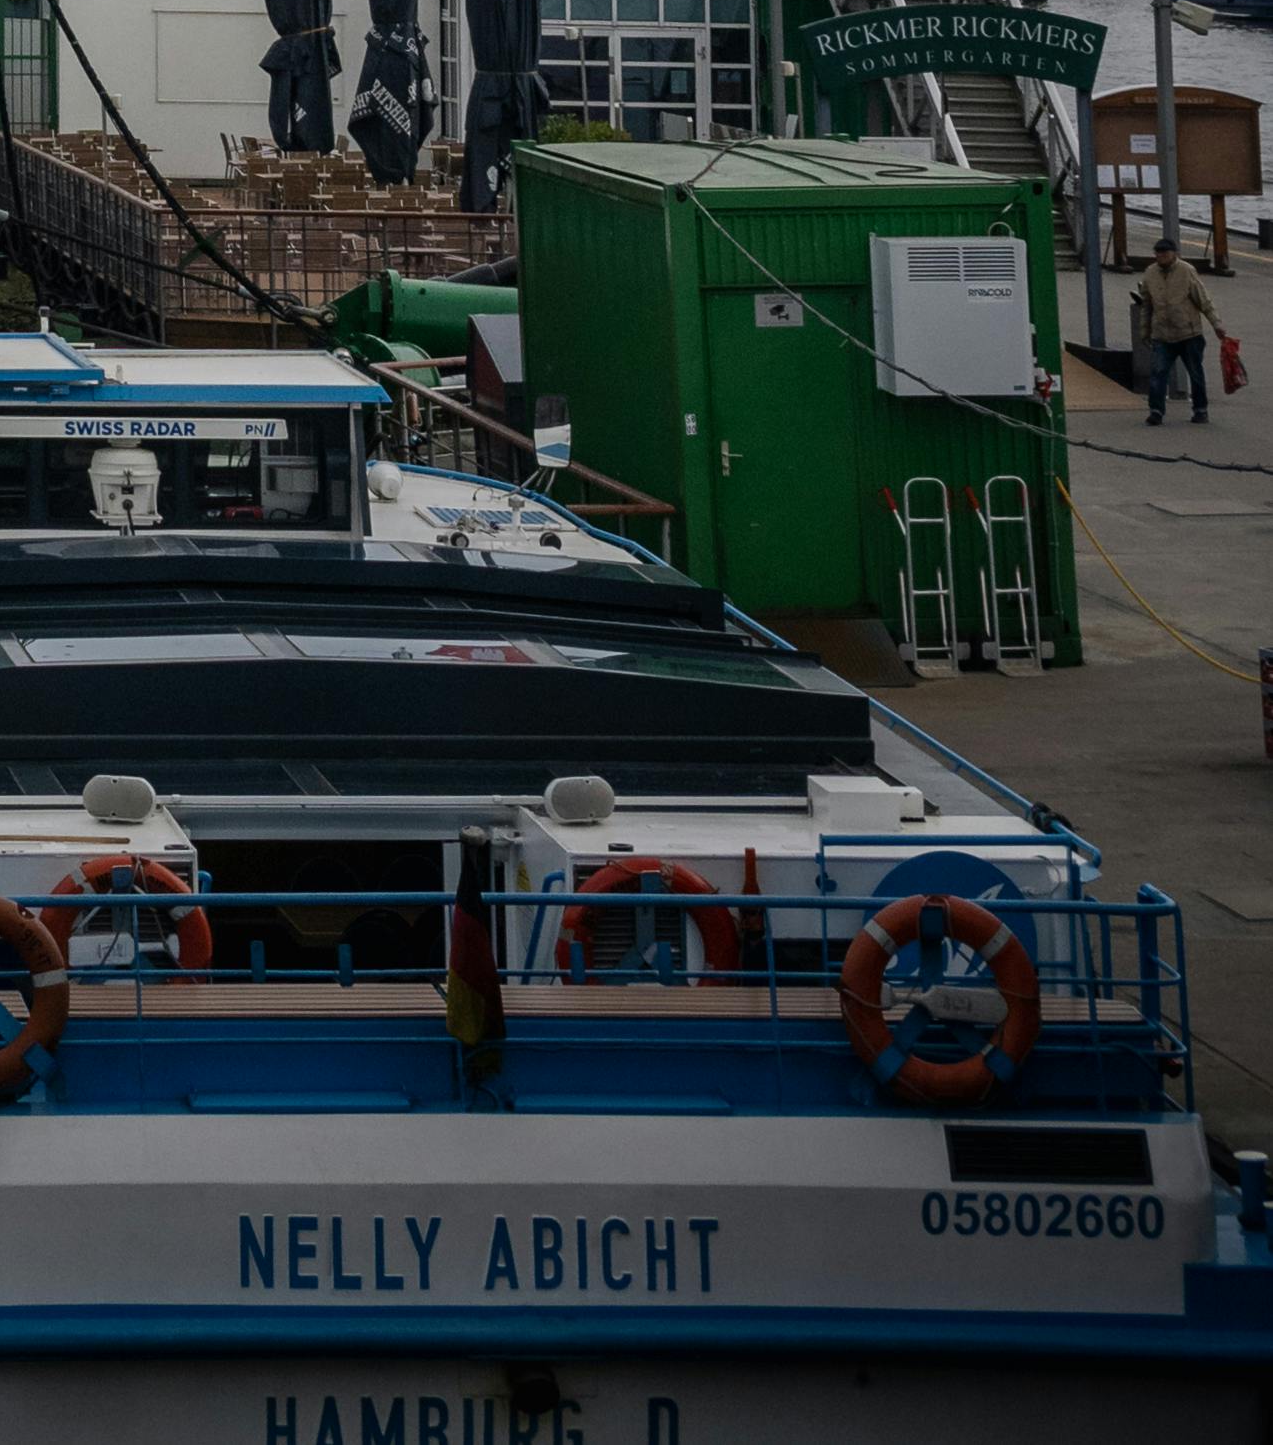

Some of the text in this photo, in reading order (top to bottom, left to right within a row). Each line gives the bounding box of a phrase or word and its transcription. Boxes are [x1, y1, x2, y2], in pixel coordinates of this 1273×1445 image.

[815, 16, 1097, 55] RICKMER RICKMERS
[845, 49, 1067, 75] SOMMERGARTEN
[65, 422, 124, 436] SWISS
[130, 422, 196, 436] RADAR
[922, 1191, 1164, 1239] 05802660
[240, 1215, 718, 1292] NELLY ABICHT
